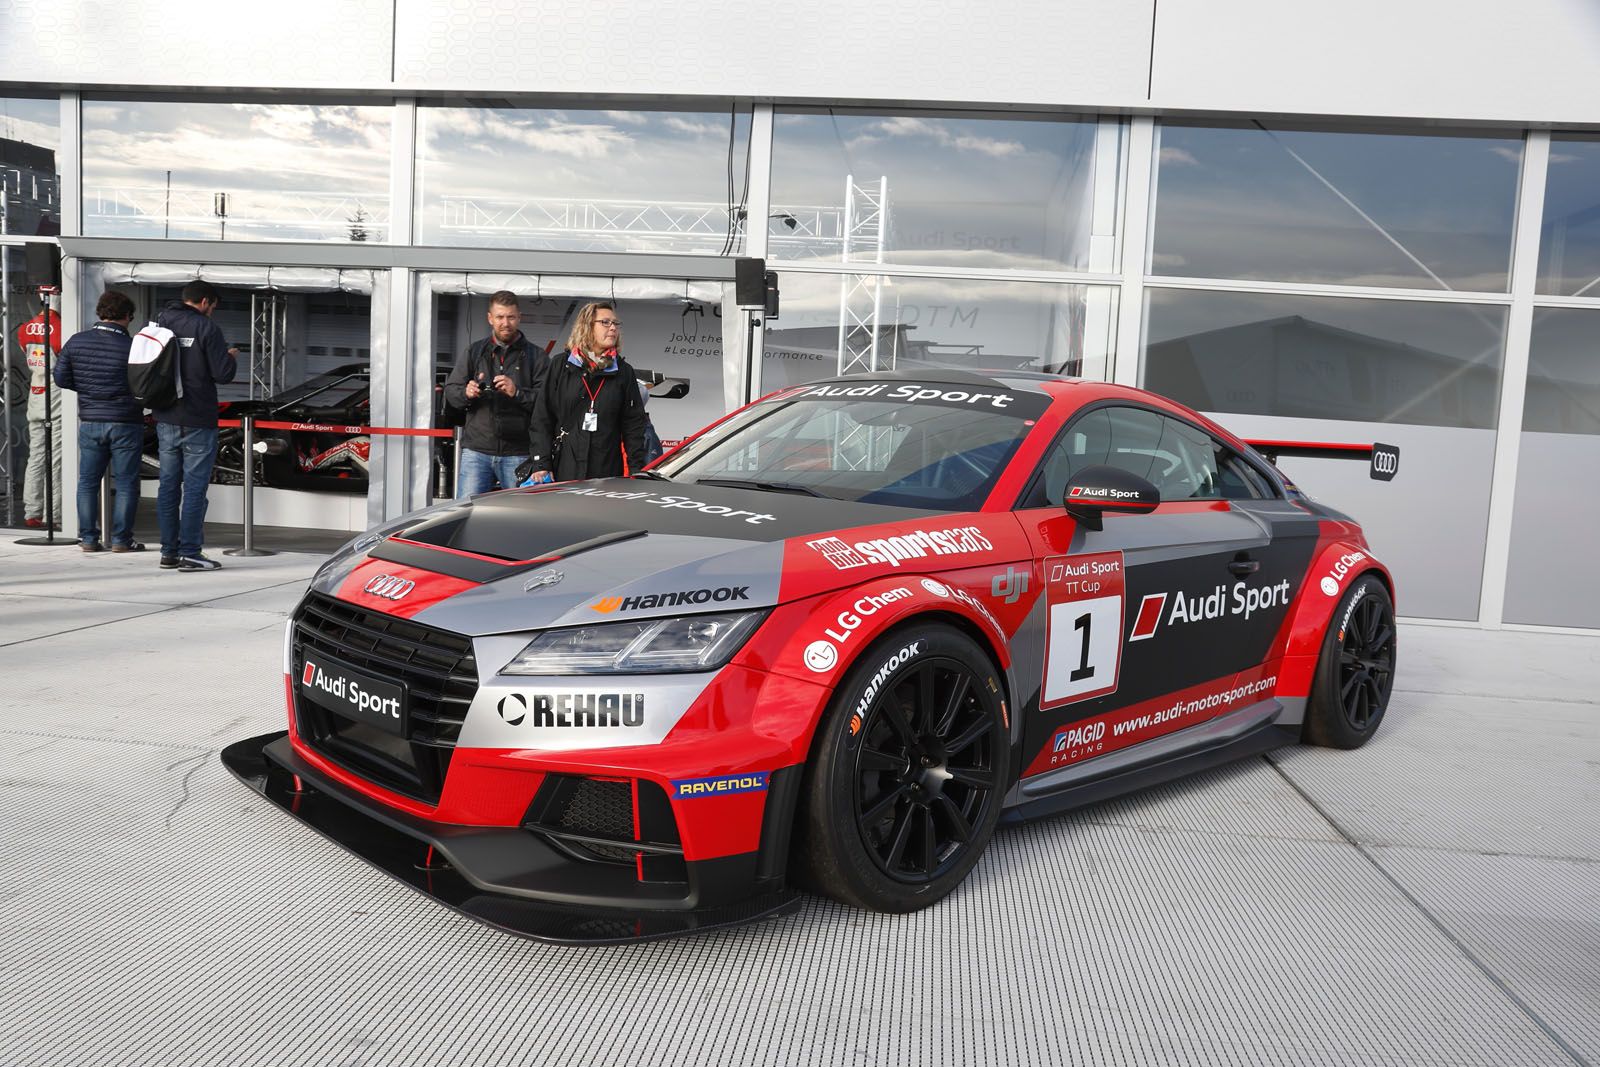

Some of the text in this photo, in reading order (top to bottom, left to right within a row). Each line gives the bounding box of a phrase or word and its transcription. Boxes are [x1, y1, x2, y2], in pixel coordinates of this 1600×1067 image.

[669, 332, 723, 344] Join the
[808, 384, 1014, 408] Audi Sport
[1083, 488, 1140, 499] Audi Sport
[570, 488, 777, 524] Audi Sport
[826, 548, 866, 568] Bild
[854, 526, 993, 567] sportscars
[1065, 561, 1120, 577] Audi Sport
[1329, 562, 1348, 581] LG
[1066, 580, 1100, 594] TT Cup
[1168, 579, 1290, 626] Audi Sport
[824, 587, 914, 643] LG Chem
[1070, 612, 1095, 682] 1
[315, 667, 400, 718] Audi Sport
[1113, 675, 1277, 736] www.audi-motorsport.com
[1066, 721, 1106, 748] PAGID
[1051, 742, 1104, 764] RACING
[680, 776, 763, 795] RAVENOL
